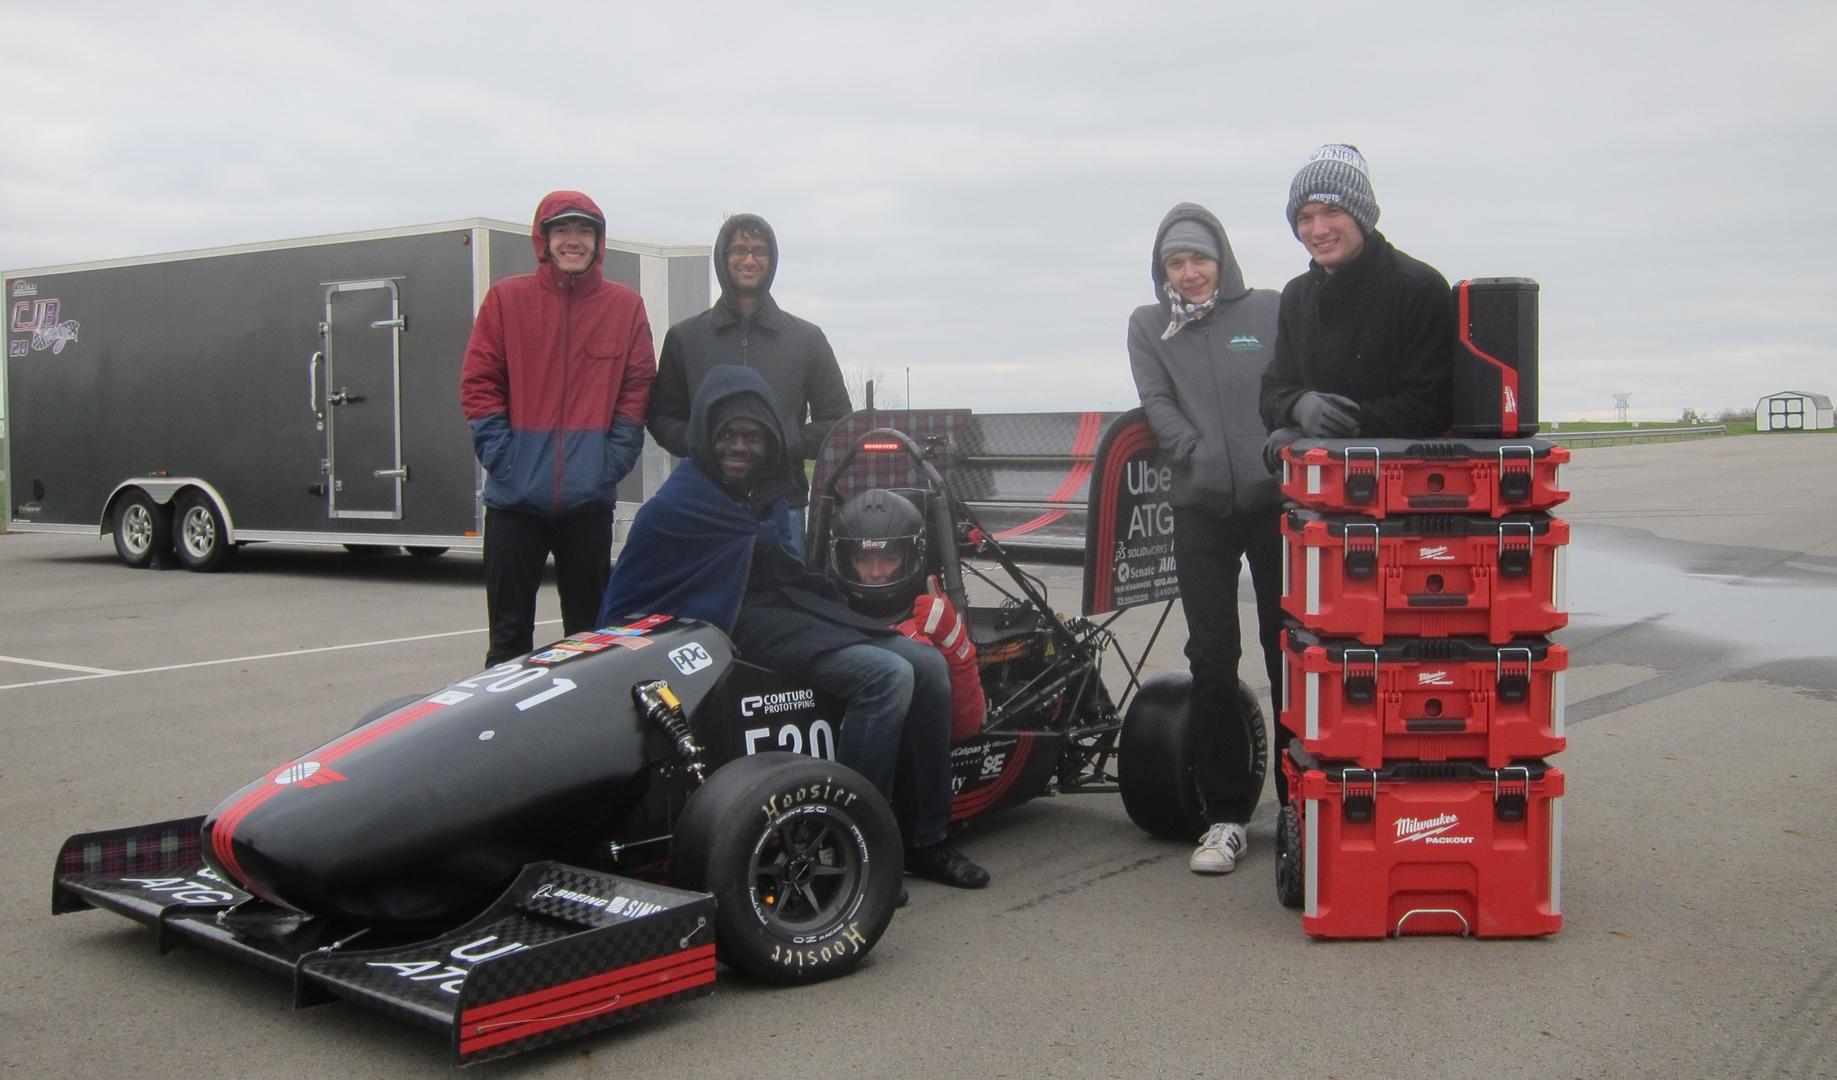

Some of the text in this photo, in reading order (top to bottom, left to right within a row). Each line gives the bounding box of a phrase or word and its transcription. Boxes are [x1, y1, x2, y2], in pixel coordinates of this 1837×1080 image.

[1128, 502, 1174, 540] ATG
[672, 644, 708, 672] PPG
[455, 663, 578, 711] 201
[764, 689, 813, 706] CONTURO
[764, 699, 815, 714] PROTOTYPING
[762, 776, 857, 825] Hoosier
[1392, 813, 1458, 837] Milwaukee
[552, 889, 609, 907] BOEING
[771, 921, 867, 974] Hoosier
